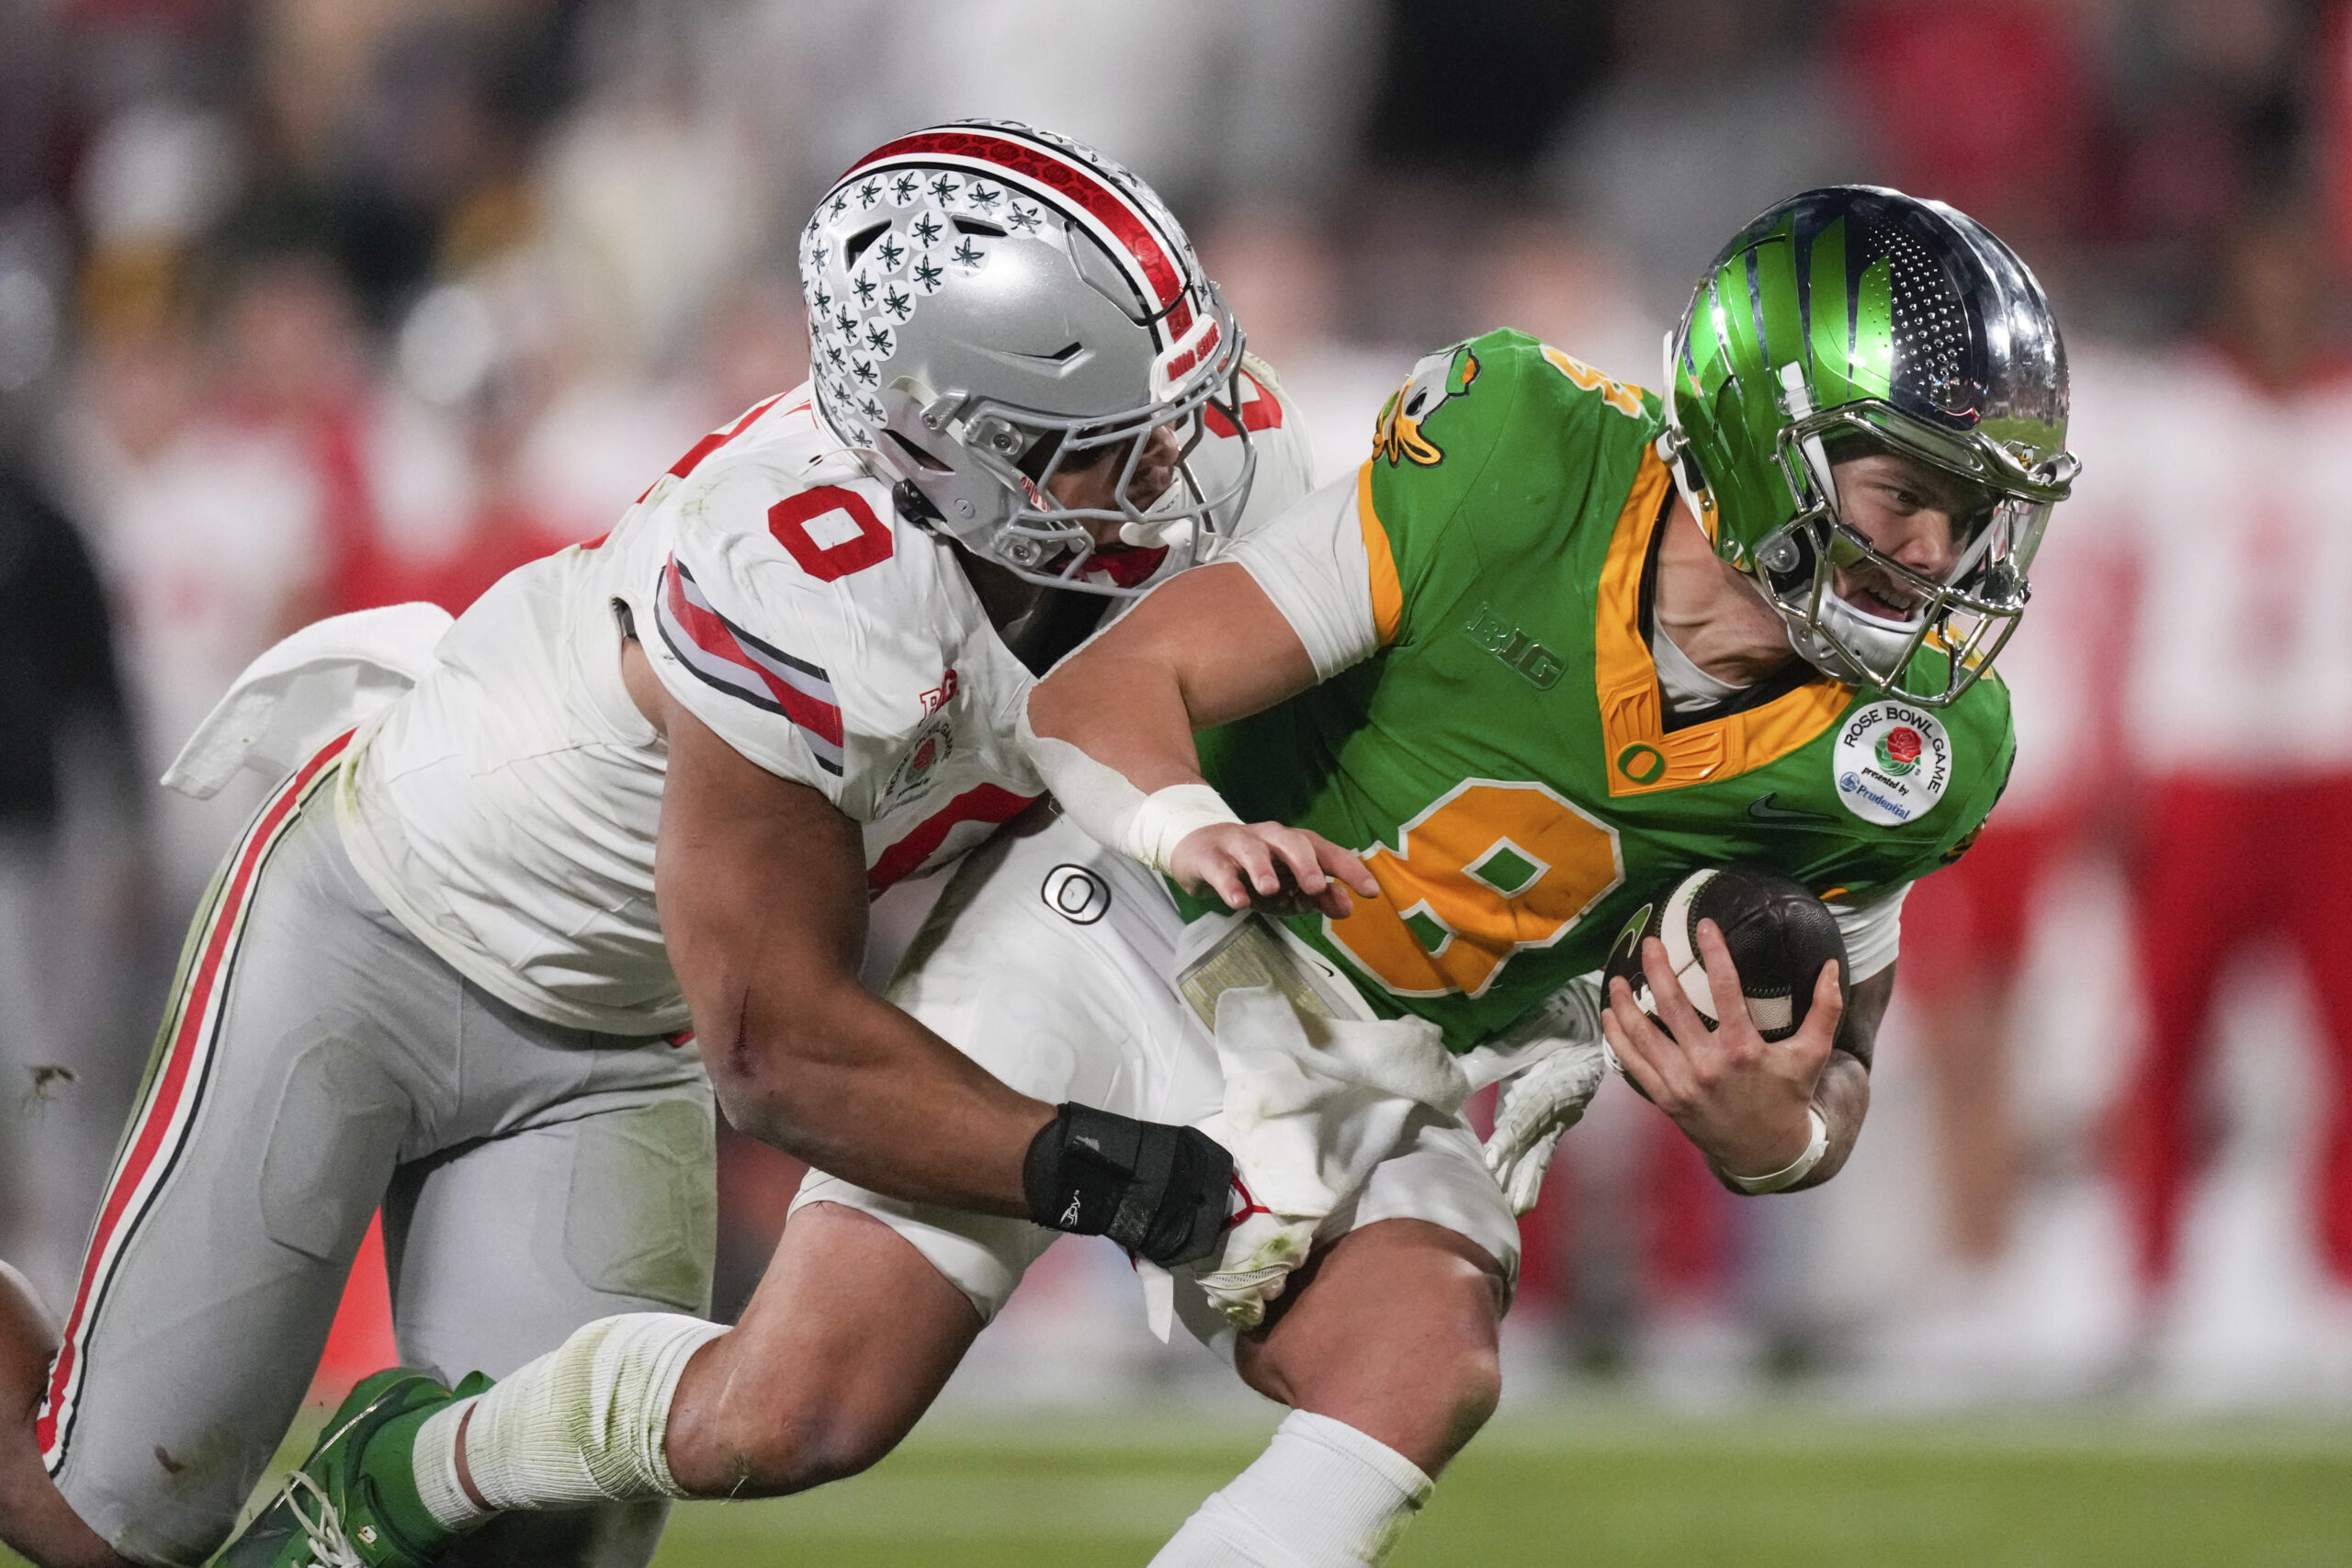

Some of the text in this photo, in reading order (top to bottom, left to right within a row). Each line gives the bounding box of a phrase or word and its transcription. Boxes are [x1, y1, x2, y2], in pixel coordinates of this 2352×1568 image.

[1844, 706, 1946, 794] ROSE BOWL GAME
[1861, 766, 1909, 795] presented by
[1856, 784, 1911, 820] Prudential
[1322, 777, 1626, 999] 8
